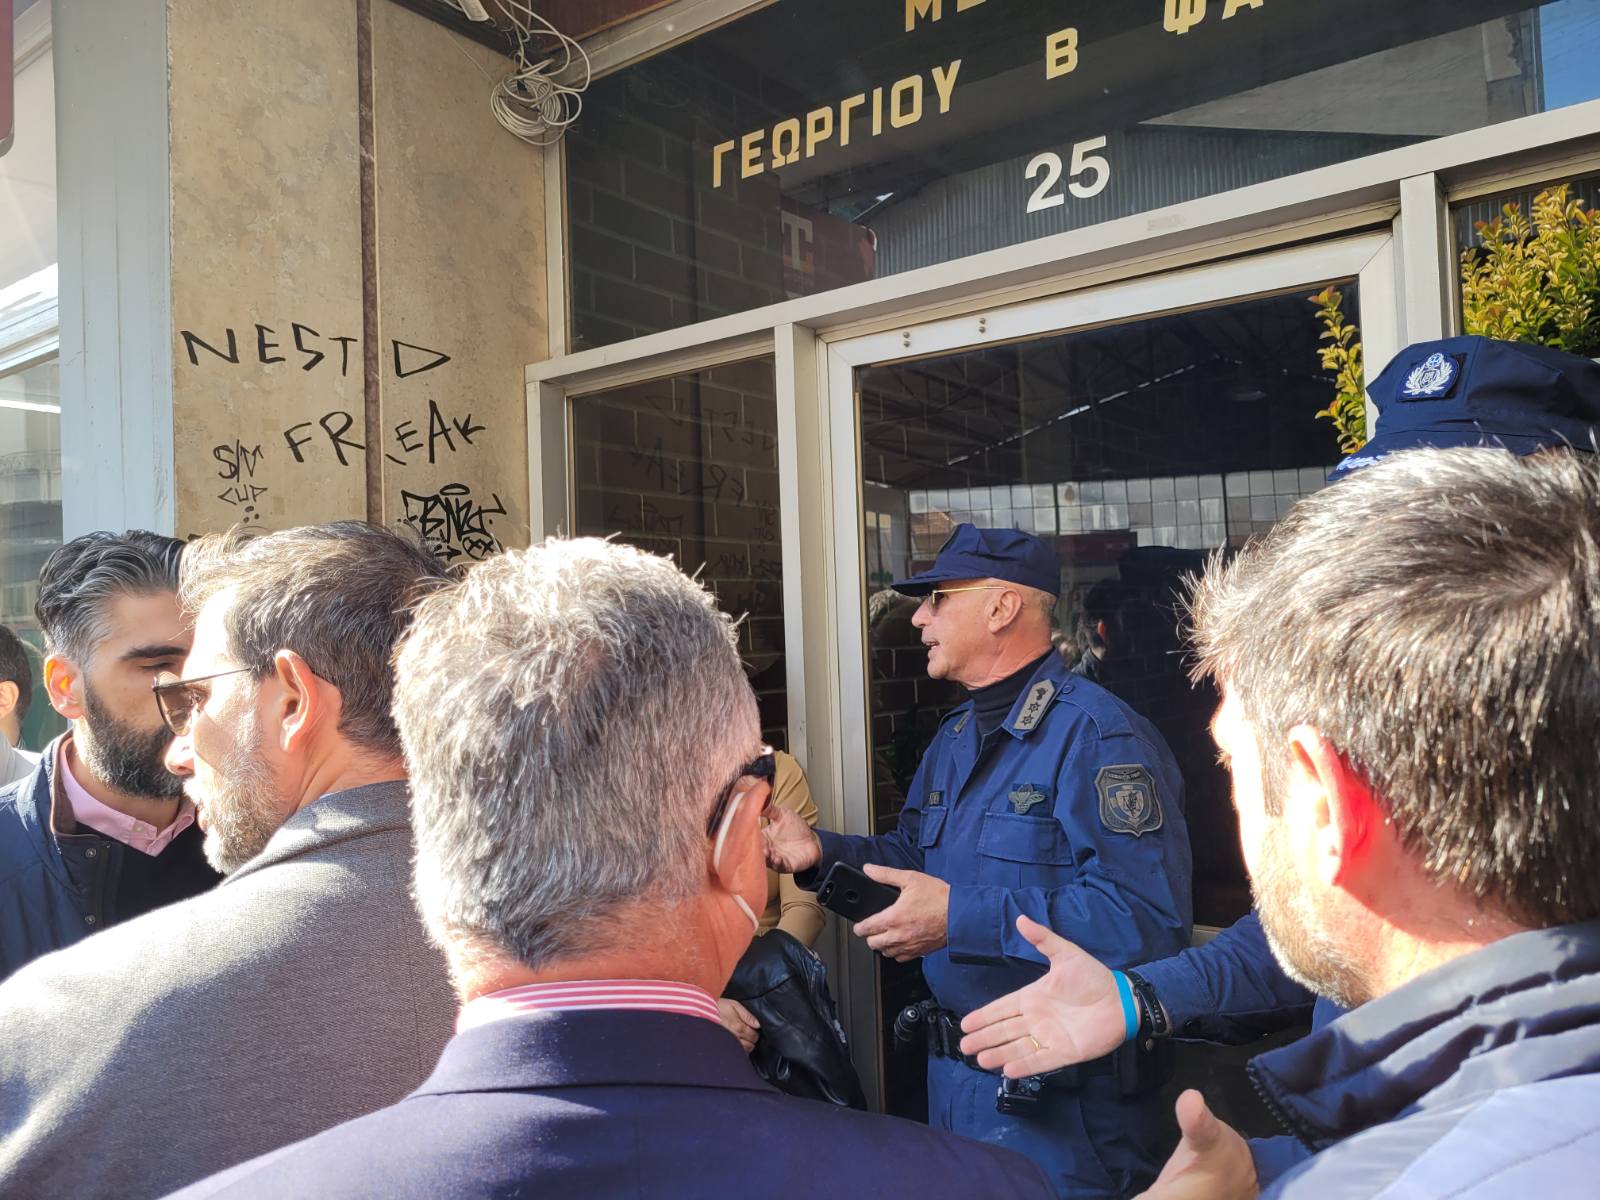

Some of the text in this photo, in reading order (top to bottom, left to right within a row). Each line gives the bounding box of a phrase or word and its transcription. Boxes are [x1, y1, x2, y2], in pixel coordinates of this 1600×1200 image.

[712, 59, 962, 188] ΓΕΩΡΓΙΟΥ
[1045, 27, 1079, 80] Β
[1024, 135, 1111, 213] 25
[283, 400, 487, 467] FREAK
